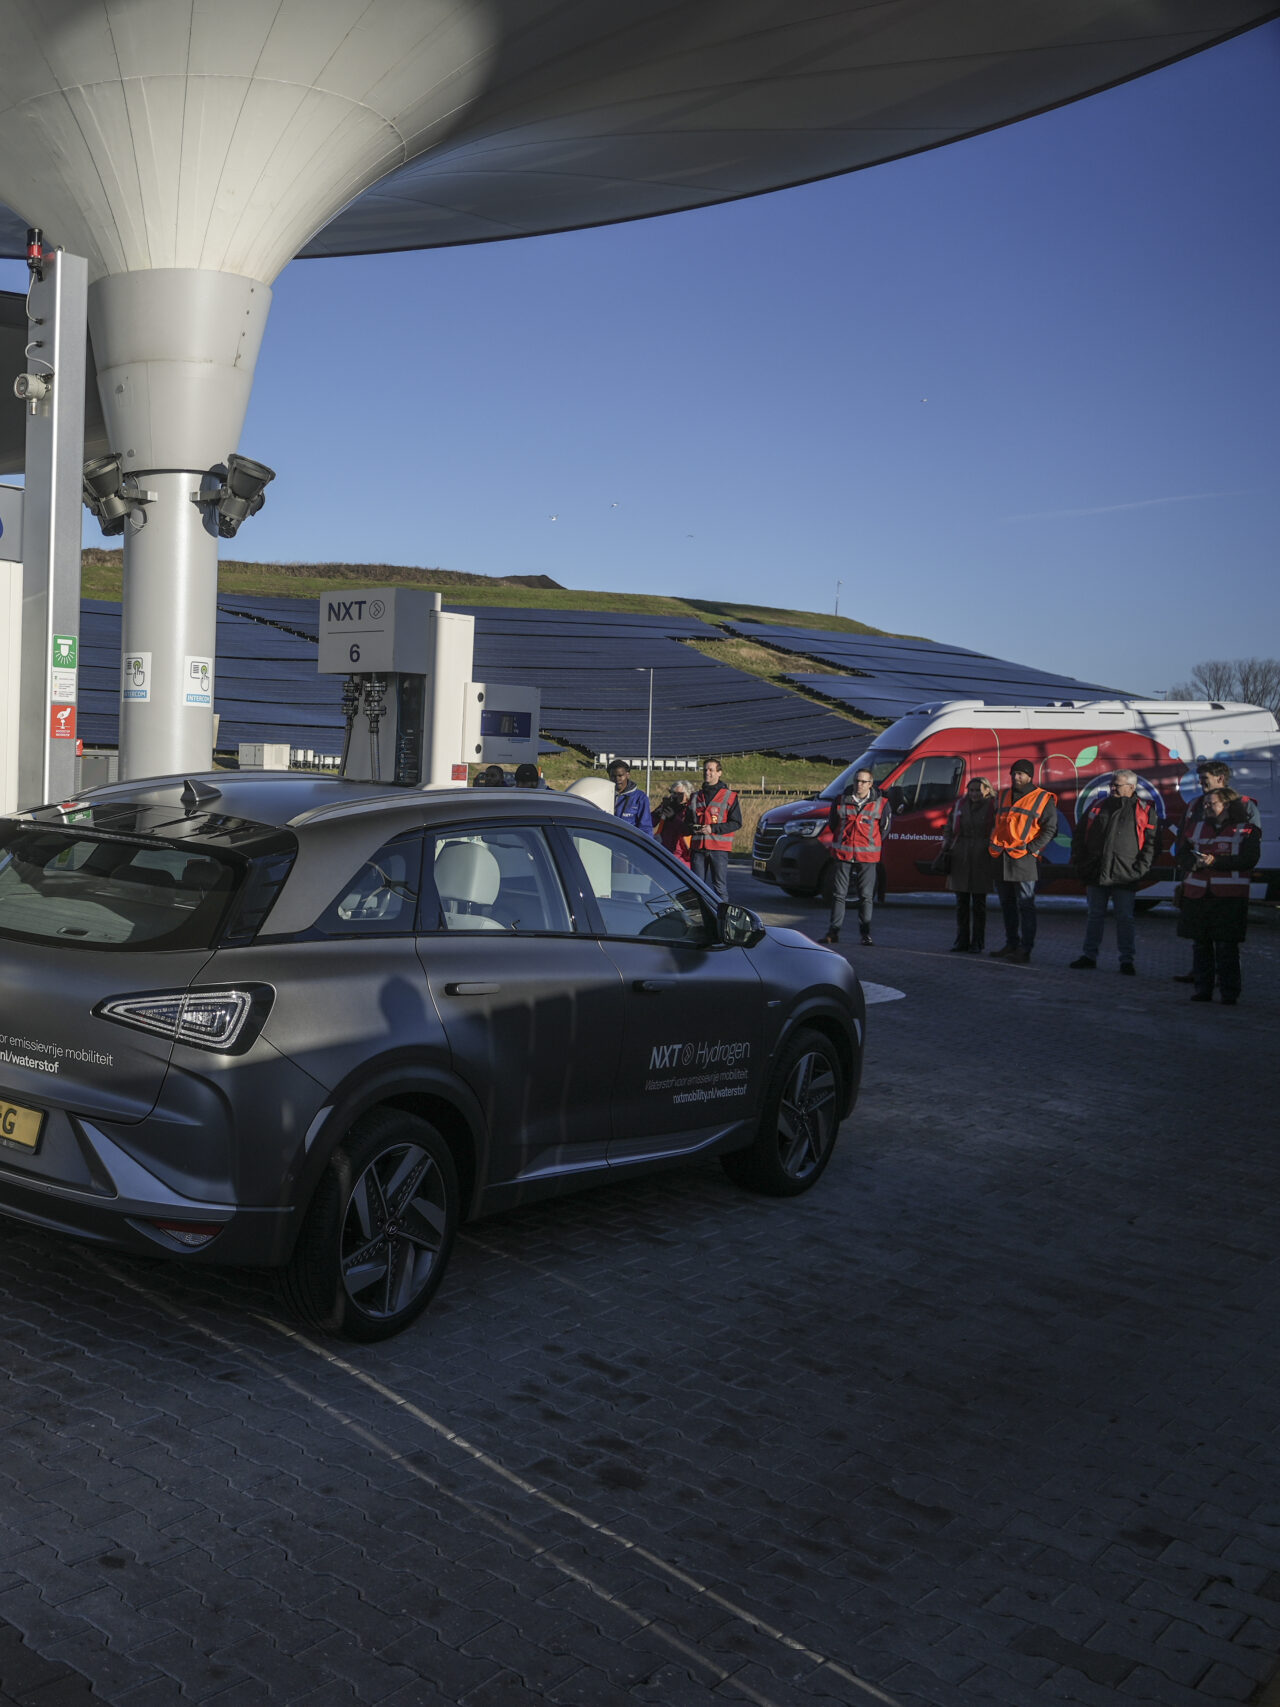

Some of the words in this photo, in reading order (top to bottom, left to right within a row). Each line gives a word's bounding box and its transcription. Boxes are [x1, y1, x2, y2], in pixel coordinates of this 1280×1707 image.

[327, 600, 367, 622] NXT
[349, 643, 360, 663] 6
[900, 833, 944, 841] Adviesburea
[9, 1036, 64, 1058] emissievrije
[65, 1048, 114, 1066] mobiliteit
[649, 1043, 683, 1070] NXT
[695, 1039, 751, 1070] Hydrogen
[645, 1078, 674, 1091] Waterstof
[720, 1068, 749, 1080] mobiliteit
[673, 1083, 748, 1104] nxtmobility.nl/waterstof
